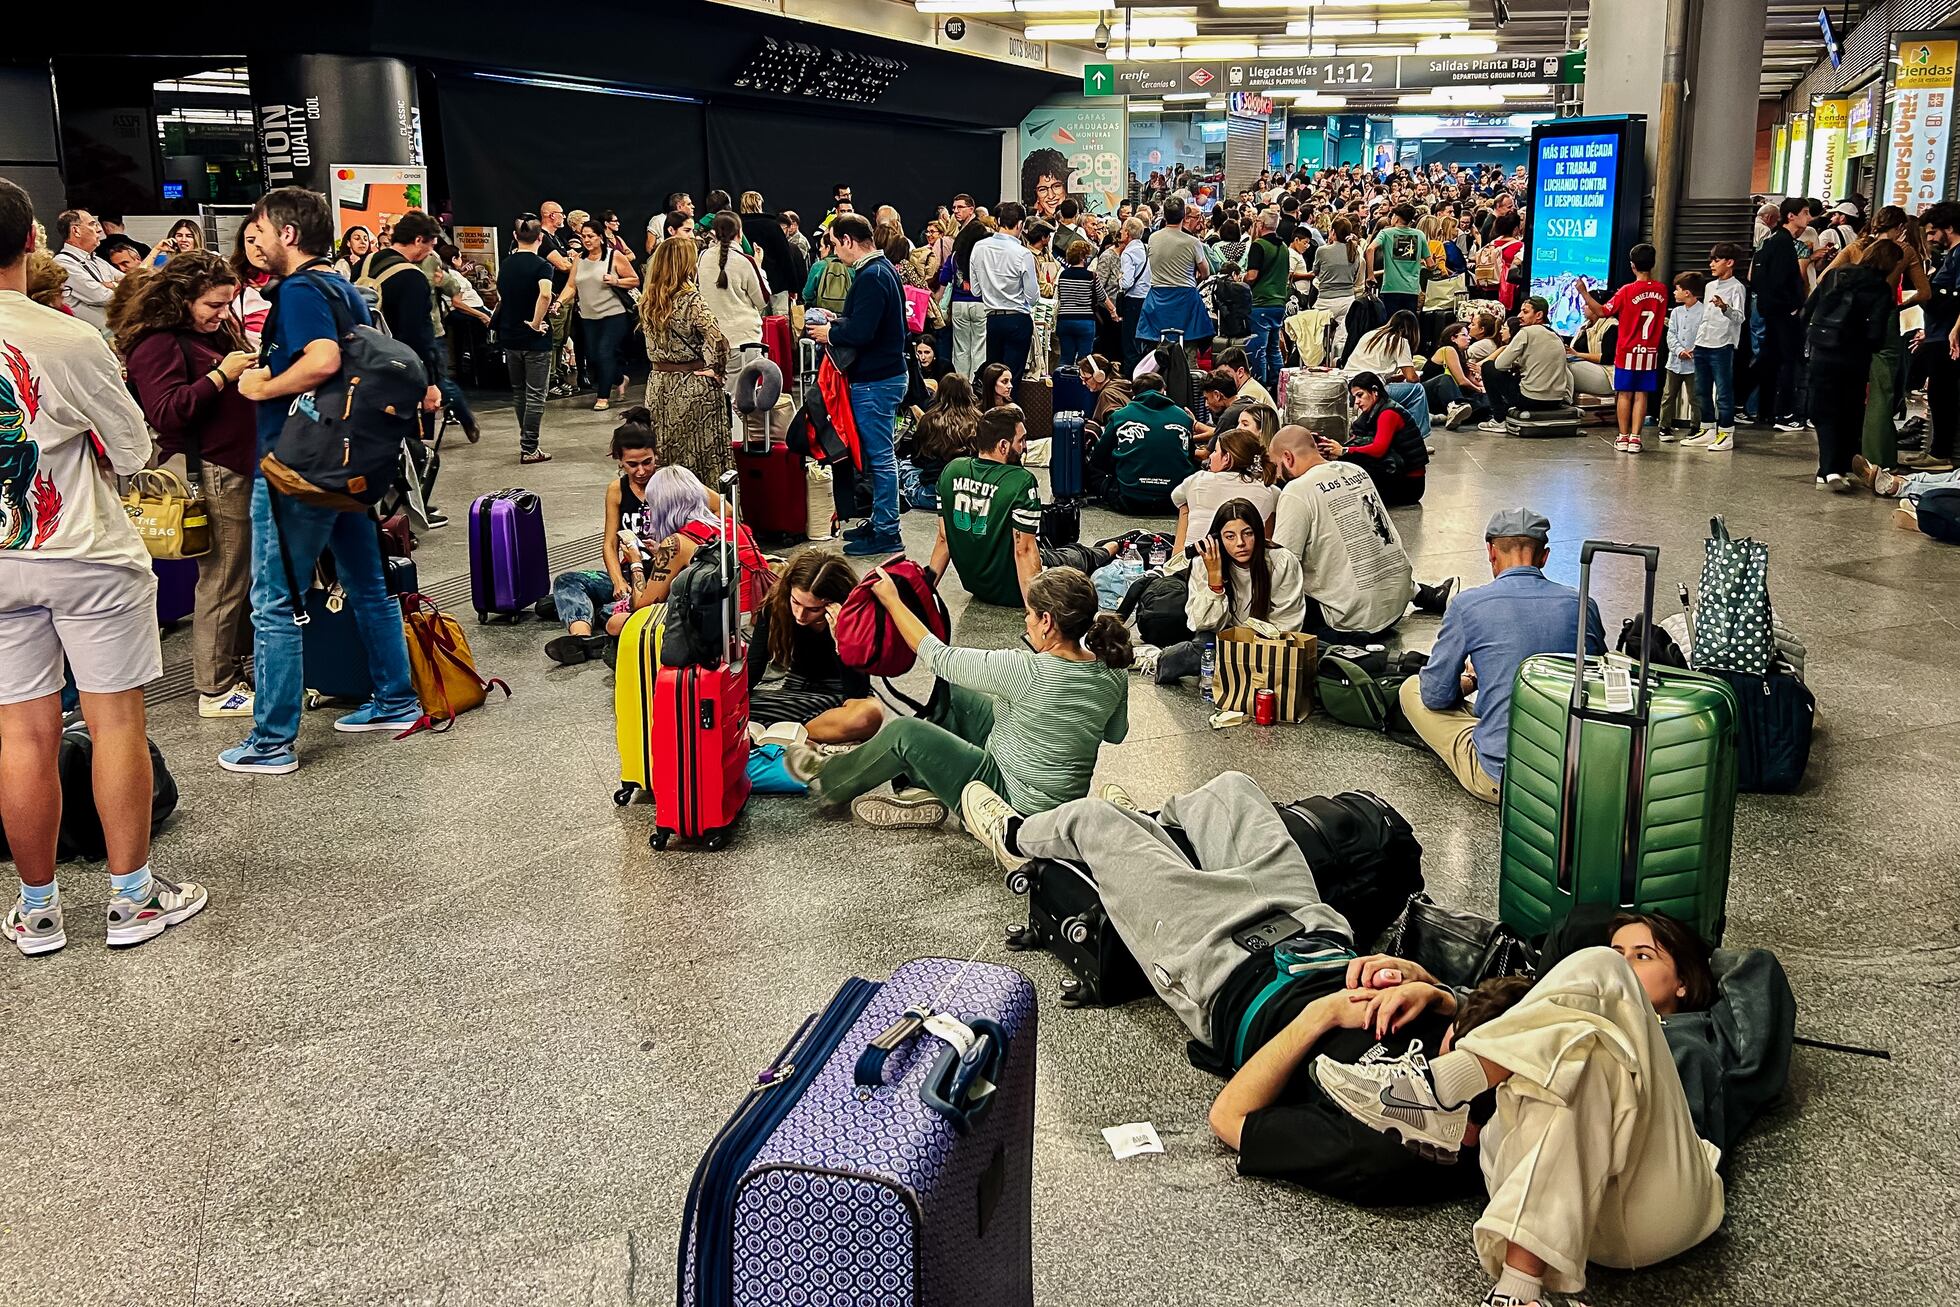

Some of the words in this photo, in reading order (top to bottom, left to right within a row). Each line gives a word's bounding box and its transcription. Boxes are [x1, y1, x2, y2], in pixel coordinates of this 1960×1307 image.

[947, 22, 962, 32] DOTS
[1009, 36, 1024, 58] DOTS
[1024, 41, 1044, 62] BAKERY
[1248, 66, 1294, 78] Llegadas
[1296, 65, 1318, 76] Vías
[1429, 60, 1469, 72] Salidas
[1472, 59, 1508, 71] Planta
[1511, 57, 1537, 70] Baja
[1898, 65, 1953, 77] tiendas
[1119, 69, 1150, 82] renfe
[1323, 63, 1336, 84] 1
[1345, 62, 1374, 84] 12
[1452, 72, 1490, 80] DEPARTURES
[1490, 72, 1517, 80] GROUND
[1517, 71, 1536, 79] FLOOR
[1925, 74, 1952, 83] estación
[1141, 80, 1169, 89] Cercanías
[306, 95, 320, 120] COOL
[397, 100, 408, 137] CLASSIC
[1077, 113, 1106, 121] GAFAS
[1066, 122, 1120, 131] GRADUADAS
[287, 104, 311, 167] QUALITY
[1542, 144, 1559, 160] MÁS
[1559, 145, 1569, 159] DE
[1569, 144, 1584, 158] UNA
[1585, 141, 1614, 158] DÉCADA
[1067, 152, 1121, 194] 29
[1555, 162, 1565, 175] DE
[1566, 161, 1597, 175] TRABAJO
[1543, 178, 1579, 192] LUCHANDO
[1579, 177, 1607, 191] CONTRA
[1544, 194, 1553, 208] LA
[1554, 191, 1605, 208] DESPOBLACIÓN
[1546, 218, 1583, 237] SSPA
[1641, 310, 1655, 340] 7
[1632, 343, 1647, 353] ria
[952, 477, 999, 498] MALFOY
[1315, 479, 1341, 494] Los
[138, 517, 158, 526] THE
[952, 492, 991, 536] 07
[149, 528, 176, 536] BAG
